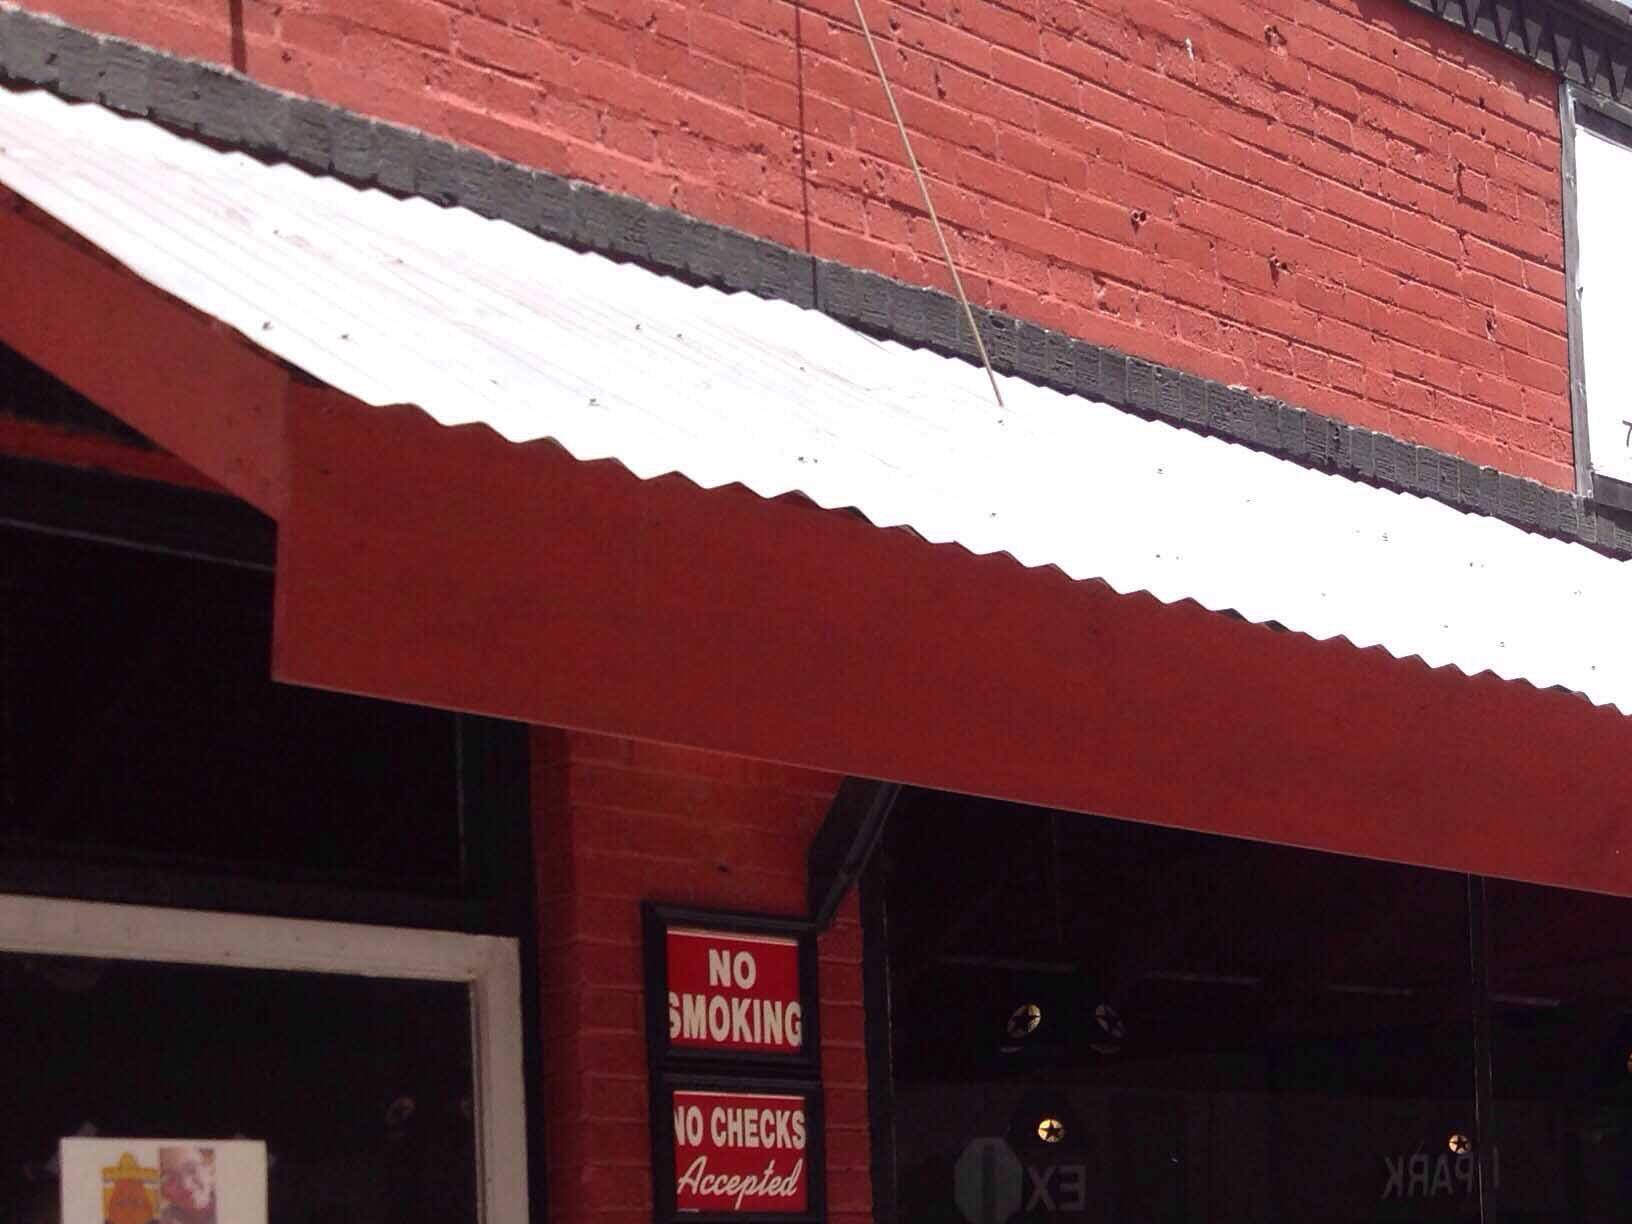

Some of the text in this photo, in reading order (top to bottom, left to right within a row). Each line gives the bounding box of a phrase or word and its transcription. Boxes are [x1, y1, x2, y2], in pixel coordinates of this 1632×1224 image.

[708, 949, 756, 990] NO
[668, 991, 803, 1047] SMOKING
[710, 1106, 806, 1150] CHECKS
[677, 1155, 804, 1211] Accepted
